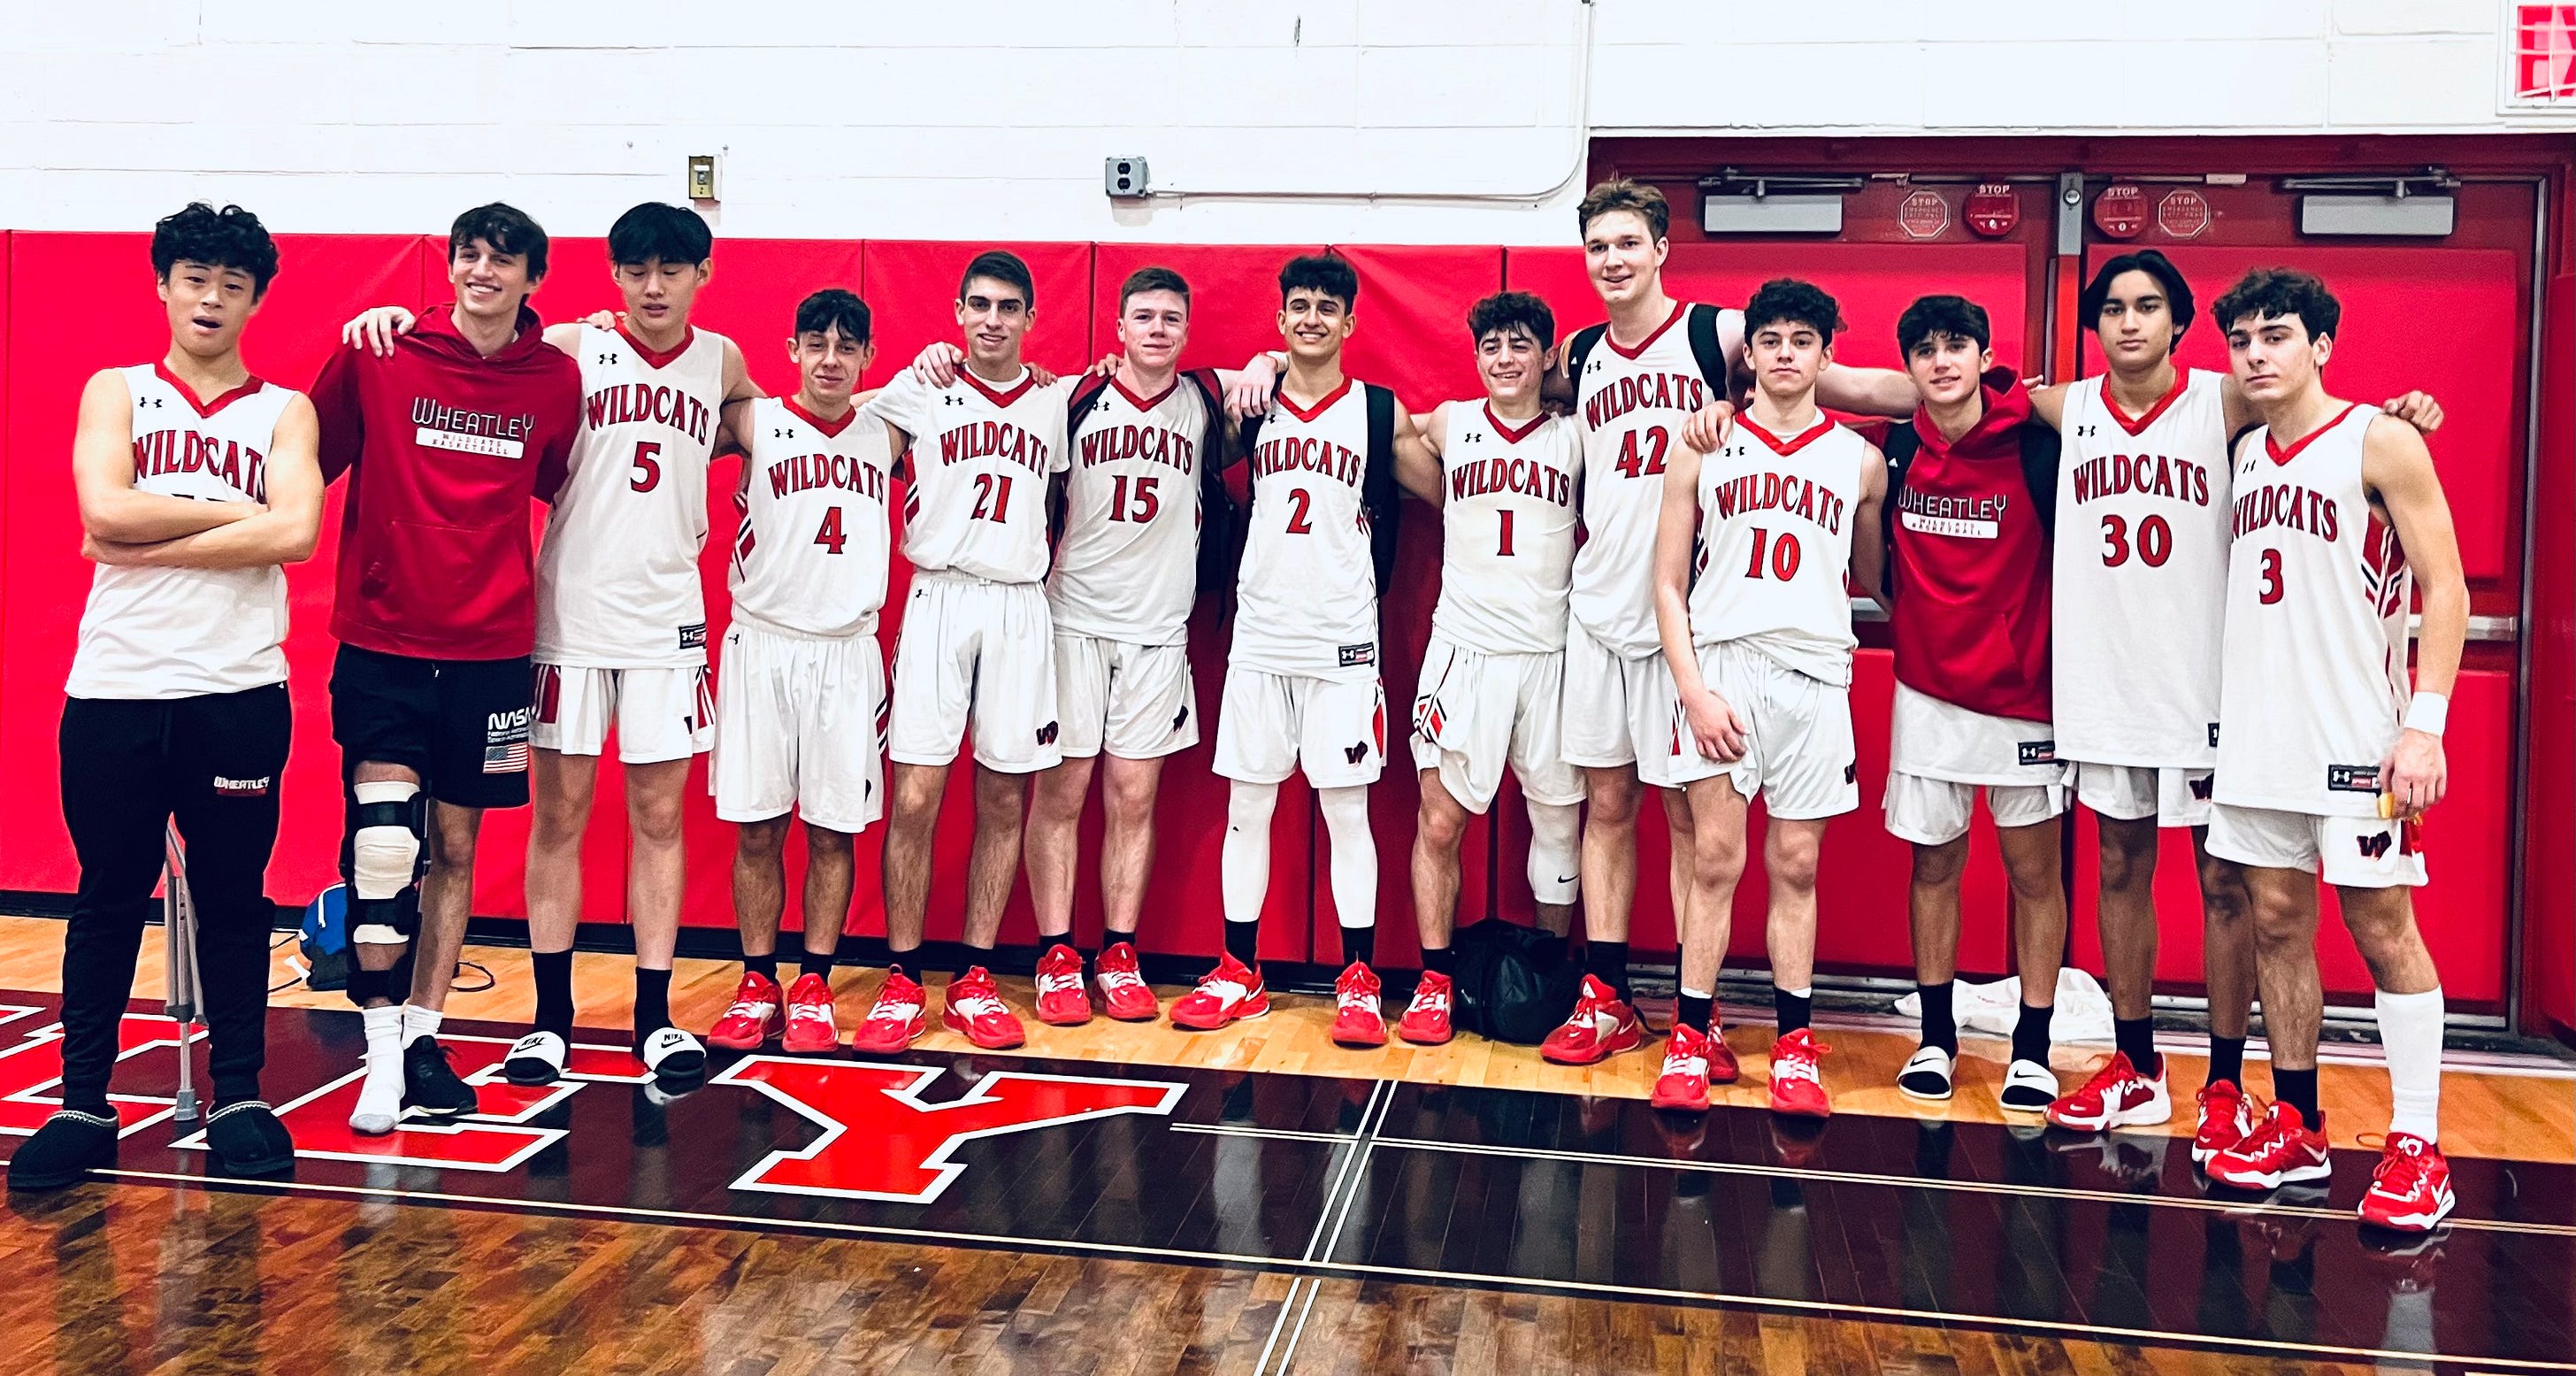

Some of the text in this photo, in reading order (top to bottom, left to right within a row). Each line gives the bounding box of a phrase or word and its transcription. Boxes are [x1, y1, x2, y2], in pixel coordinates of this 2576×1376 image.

[1979, 184, 2010, 195] STOP
[2107, 187, 2139, 197] STOP
[2170, 196, 2197, 205] STOP
[412, 396, 535, 442] WHEATLEY
[587, 383, 709, 446] WILDCATS
[1586, 373, 1703, 432] WILDCATS
[630, 441, 661, 493] 5
[939, 420, 1047, 480] WILDCATS
[1081, 425, 1193, 475] WILDCATS
[1254, 437, 1361, 488] WILDCATS
[1614, 426, 1668, 479] 42
[768, 453, 884, 506] WILDCATS
[970, 473, 1013, 524] 21
[1108, 475, 1159, 524] 15
[1452, 458, 1569, 507] WILDCATS
[1715, 473, 1844, 535] WILDCATS
[1898, 484, 2006, 522] WHEATLEY
[2074, 454, 2209, 506] WILDCATS
[813, 506, 847, 554] 4
[1285, 488, 1312, 534] 2
[1496, 509, 1514, 556] 1
[1744, 527, 1801, 581] 10
[2101, 514, 2172, 567] 30
[2259, 549, 2284, 604] 3
